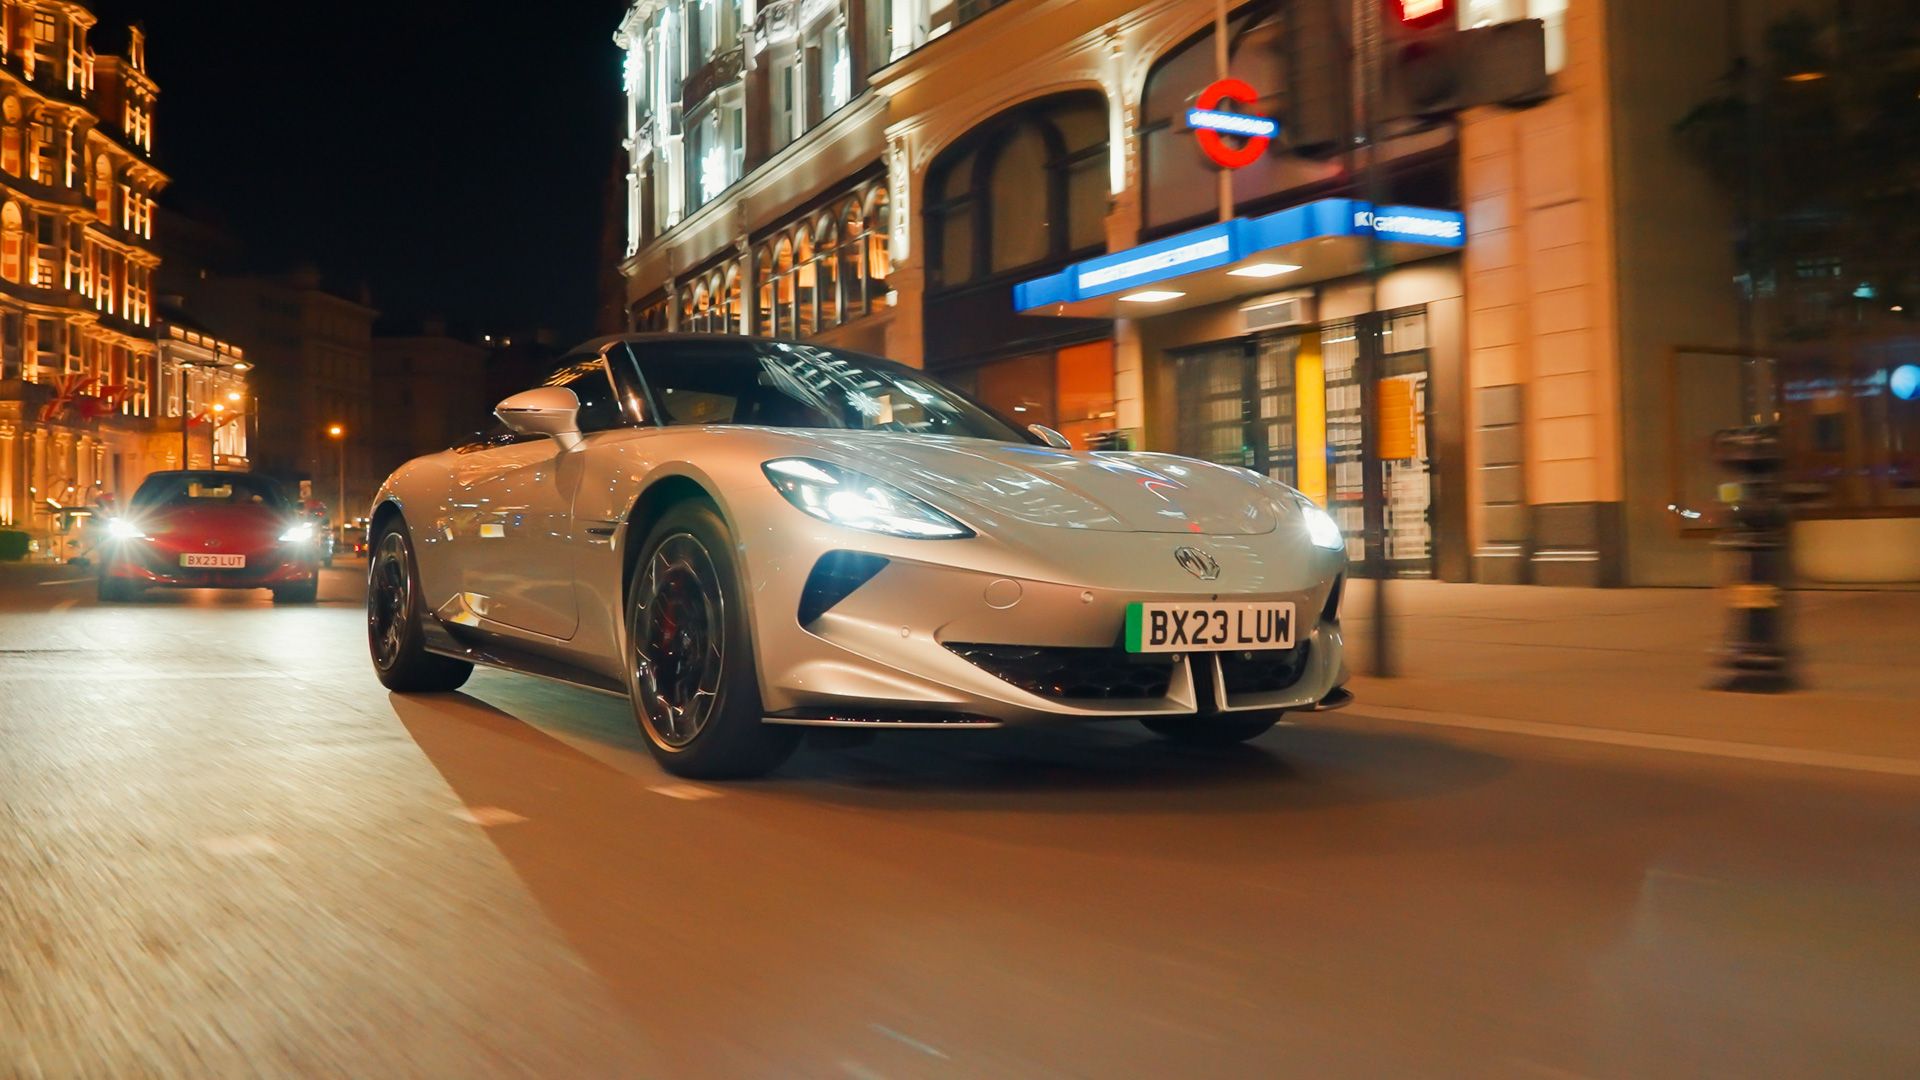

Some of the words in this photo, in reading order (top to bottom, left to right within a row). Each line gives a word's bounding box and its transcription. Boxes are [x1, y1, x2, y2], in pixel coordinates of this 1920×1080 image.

[188, 556, 217, 565] BX23
[221, 557, 243, 566] LUT
[1149, 610, 1229, 646] BX23
[1237, 609, 1291, 644] LUW
